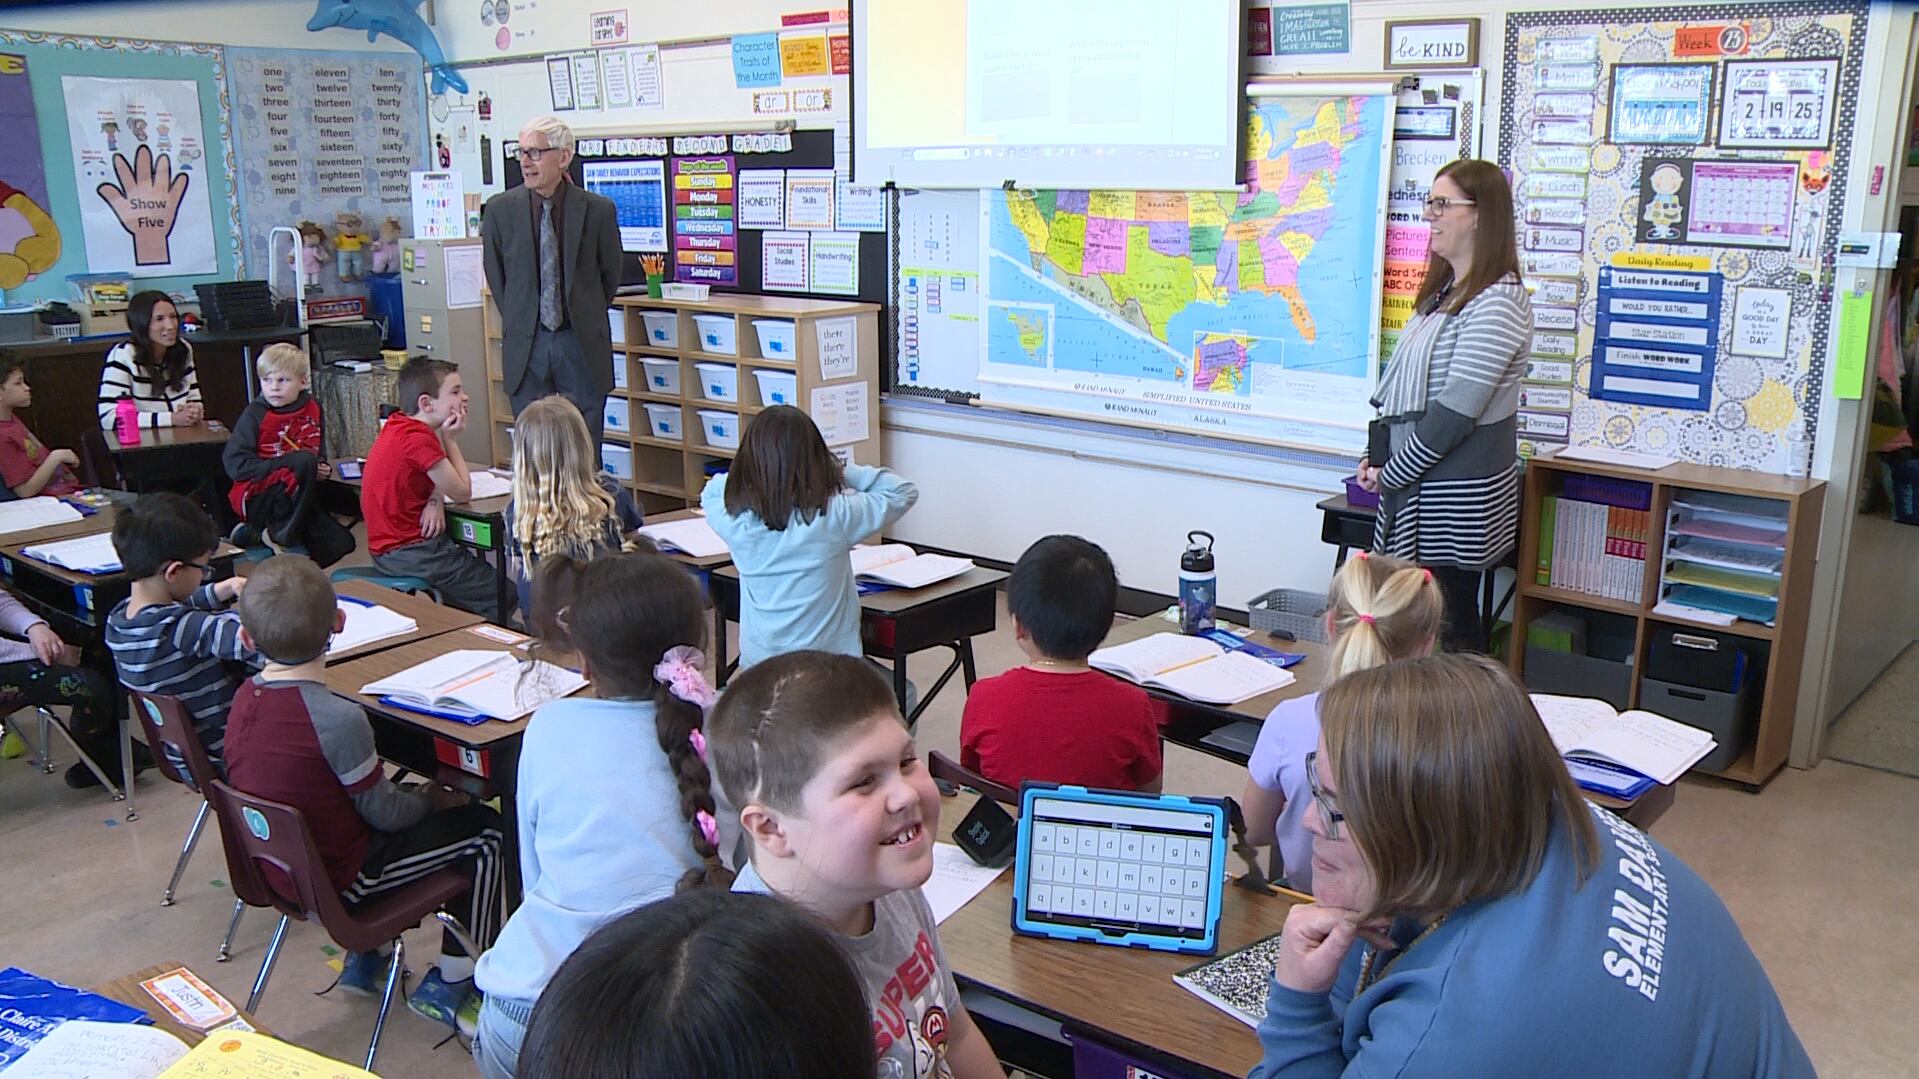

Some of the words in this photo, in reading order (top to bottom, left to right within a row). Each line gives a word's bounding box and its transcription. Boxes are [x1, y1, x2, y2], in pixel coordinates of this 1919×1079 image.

[733, 40, 774, 53] Character
[1396, 37, 1418, 57] be
[1423, 43, 1465, 57] KIND
[1678, 35, 1713, 50] Week
[741, 58, 760, 67] Traits
[762, 56, 770, 65] of
[380, 69, 394, 77] ten
[737, 73, 750, 82] the
[752, 71, 778, 81] Month
[265, 84, 284, 92] two
[316, 84, 348, 92] twelve
[372, 84, 402, 94] twenty
[263, 97, 288, 106] three
[314, 99, 351, 107] thirteen
[377, 98, 401, 108] thirty
[764, 97, 776, 108] ar
[806, 95, 818, 106] or
[1745, 102, 1754, 119] 2
[1770, 102, 1784, 117] 19
[1795, 102, 1812, 119] 25
[268, 112, 288, 121] four
[314, 114, 354, 123] fourteen
[379, 112, 400, 122] forty
[270, 127, 288, 136] five
[320, 129, 350, 138] fifteen
[382, 127, 400, 138] fifty
[273, 143, 287, 151] six
[320, 143, 354, 151] sixteen
[382, 142, 403, 152] sixty
[581, 142, 600, 152] MRS
[676, 139, 725, 152] SECOND
[376, 156, 411, 165] seventy
[1395, 146, 1447, 166] Brecken
[1548, 153, 1583, 165] Writing
[316, 158, 362, 166] seventeen
[319, 172, 360, 181] eighteen
[380, 170, 408, 179] eighty
[610, 168, 629, 177] BEHAVIOR
[271, 172, 296, 184] eight
[690, 177, 716, 186] Sunday
[275, 187, 296, 195] nine
[382, 184, 409, 193] ninety
[1549, 181, 1580, 192] Lunch
[690, 192, 718, 203] Monday
[850, 188, 872, 197] Writing
[130, 198, 166, 210] Show
[745, 197, 777, 206] HONESTY
[690, 208, 718, 218] Tuesday
[1544, 207, 1580, 219] Recess
[138, 217, 164, 228] Five
[423, 226, 458, 236] TRYING
[685, 223, 724, 234] Wednesday
[1386, 230, 1428, 242] Pictures
[1545, 234, 1575, 246] Music
[689, 237, 720, 248] Thursday
[695, 253, 716, 264] Friday
[774, 257, 795, 265] Studies
[816, 253, 852, 262] Handwriting
[1628, 256, 1653, 268] Daily
[1655, 259, 1694, 268] Reading
[690, 267, 721, 280] Saturday
[1384, 268, 1409, 277] Word
[1384, 281, 1403, 290] ABC
[1618, 276, 1649, 285] Listen
[1650, 278, 1660, 286] to
[1661, 278, 1701, 291] Reading
[1622, 303, 1645, 311] WOULD
[1648, 304, 1662, 312] YOU
[1752, 298, 1774, 312] today
[1537, 312, 1573, 325] Recess
[823, 329, 843, 339] their
[1632, 328, 1652, 338] Star
[1653, 329, 1685, 340] Station
[1542, 336, 1561, 346] Daily
[1750, 336, 1768, 344] DAY
[824, 343, 844, 353] there
[1537, 344, 1565, 354] Reading
[824, 354, 850, 368] they're
[1616, 352, 1641, 361] Finish
[1643, 354, 1666, 362] WORD
[1668, 356, 1690, 364] WORK
[1540, 364, 1559, 372] Social
[1537, 372, 1562, 380] Studies
[1142, 391, 1186, 403] SIMPLIFIED
[1189, 396, 1220, 407] UNITED
[1221, 400, 1252, 411] STATES
[1111, 404, 1129, 412] RAND
[1193, 414, 1227, 426] ALASKA
[1041, 835, 1047, 843] a
[1063, 836, 1069, 845] b
[1085, 839, 1091, 847] c
[1106, 840, 1113, 849] d
[1151, 844, 1155, 853] f
[1172, 848, 1178, 857] g
[1194, 849, 1200, 857] h
[1083, 868, 1088, 876] k
[1192, 880, 1198, 888] p
[1037, 894, 1044, 902] q
[1103, 900, 1107, 909] t
[1124, 903, 1130, 911] u
[1146, 905, 1152, 913] v
[1603, 889, 1651, 987] SAM
[1640, 865, 1669, 1002] ELEMENTARY
[0, 1008, 40, 1030] Claire
